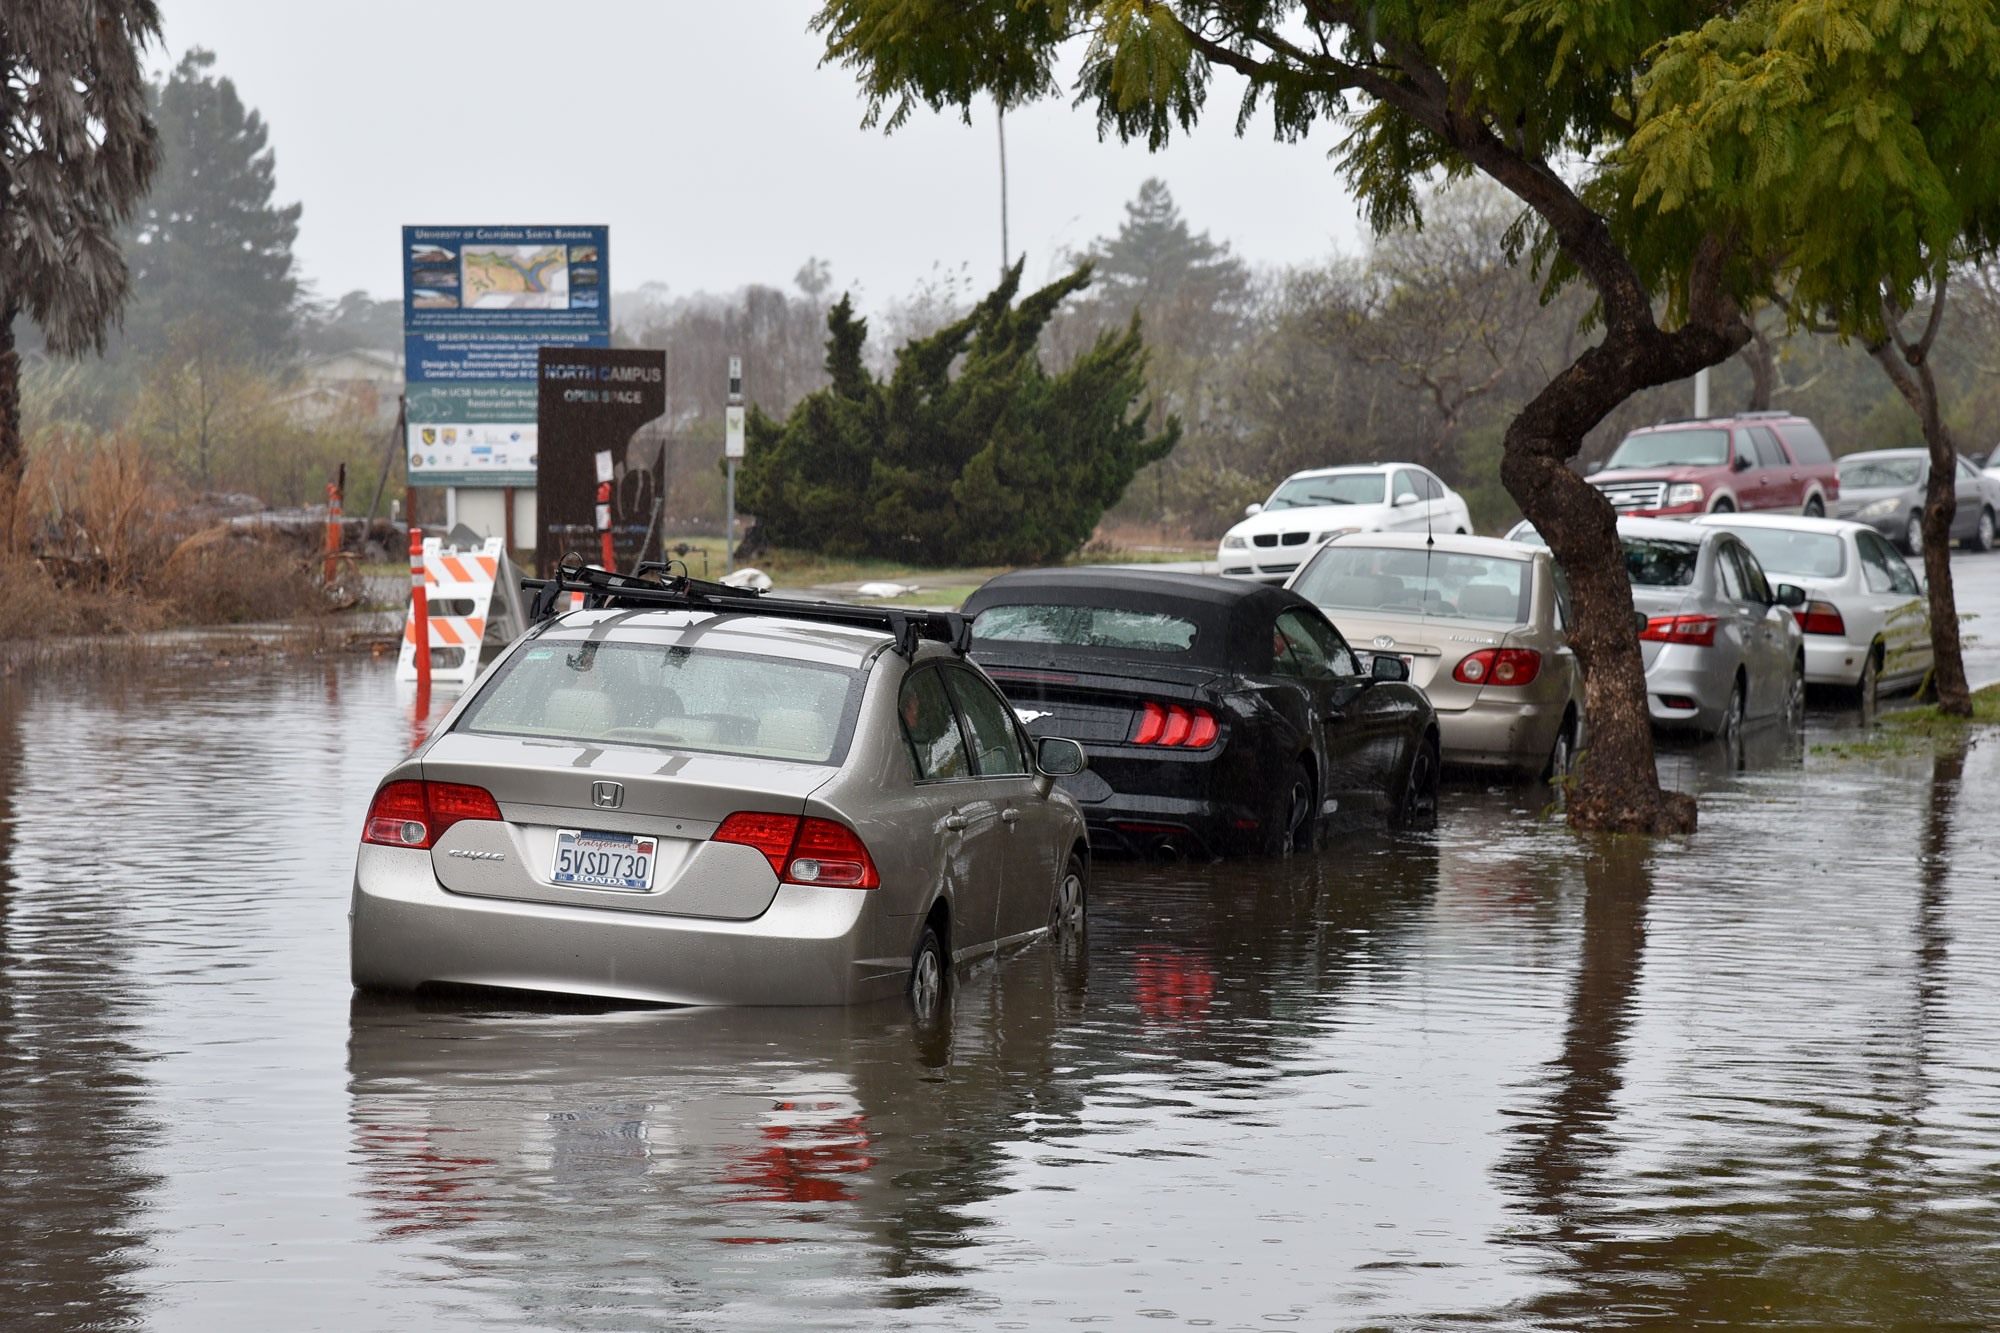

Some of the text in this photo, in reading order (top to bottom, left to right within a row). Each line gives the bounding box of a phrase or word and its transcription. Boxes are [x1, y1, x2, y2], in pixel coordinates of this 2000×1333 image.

[545, 364, 596, 379] NORTH
[600, 365, 661, 382] CAMPUS
[564, 389, 642, 403] OPEN SPACE
[449, 849, 505, 861] CIVIC
[560, 849, 648, 879] 5VSD730
[572, 874, 629, 887] HONDA
